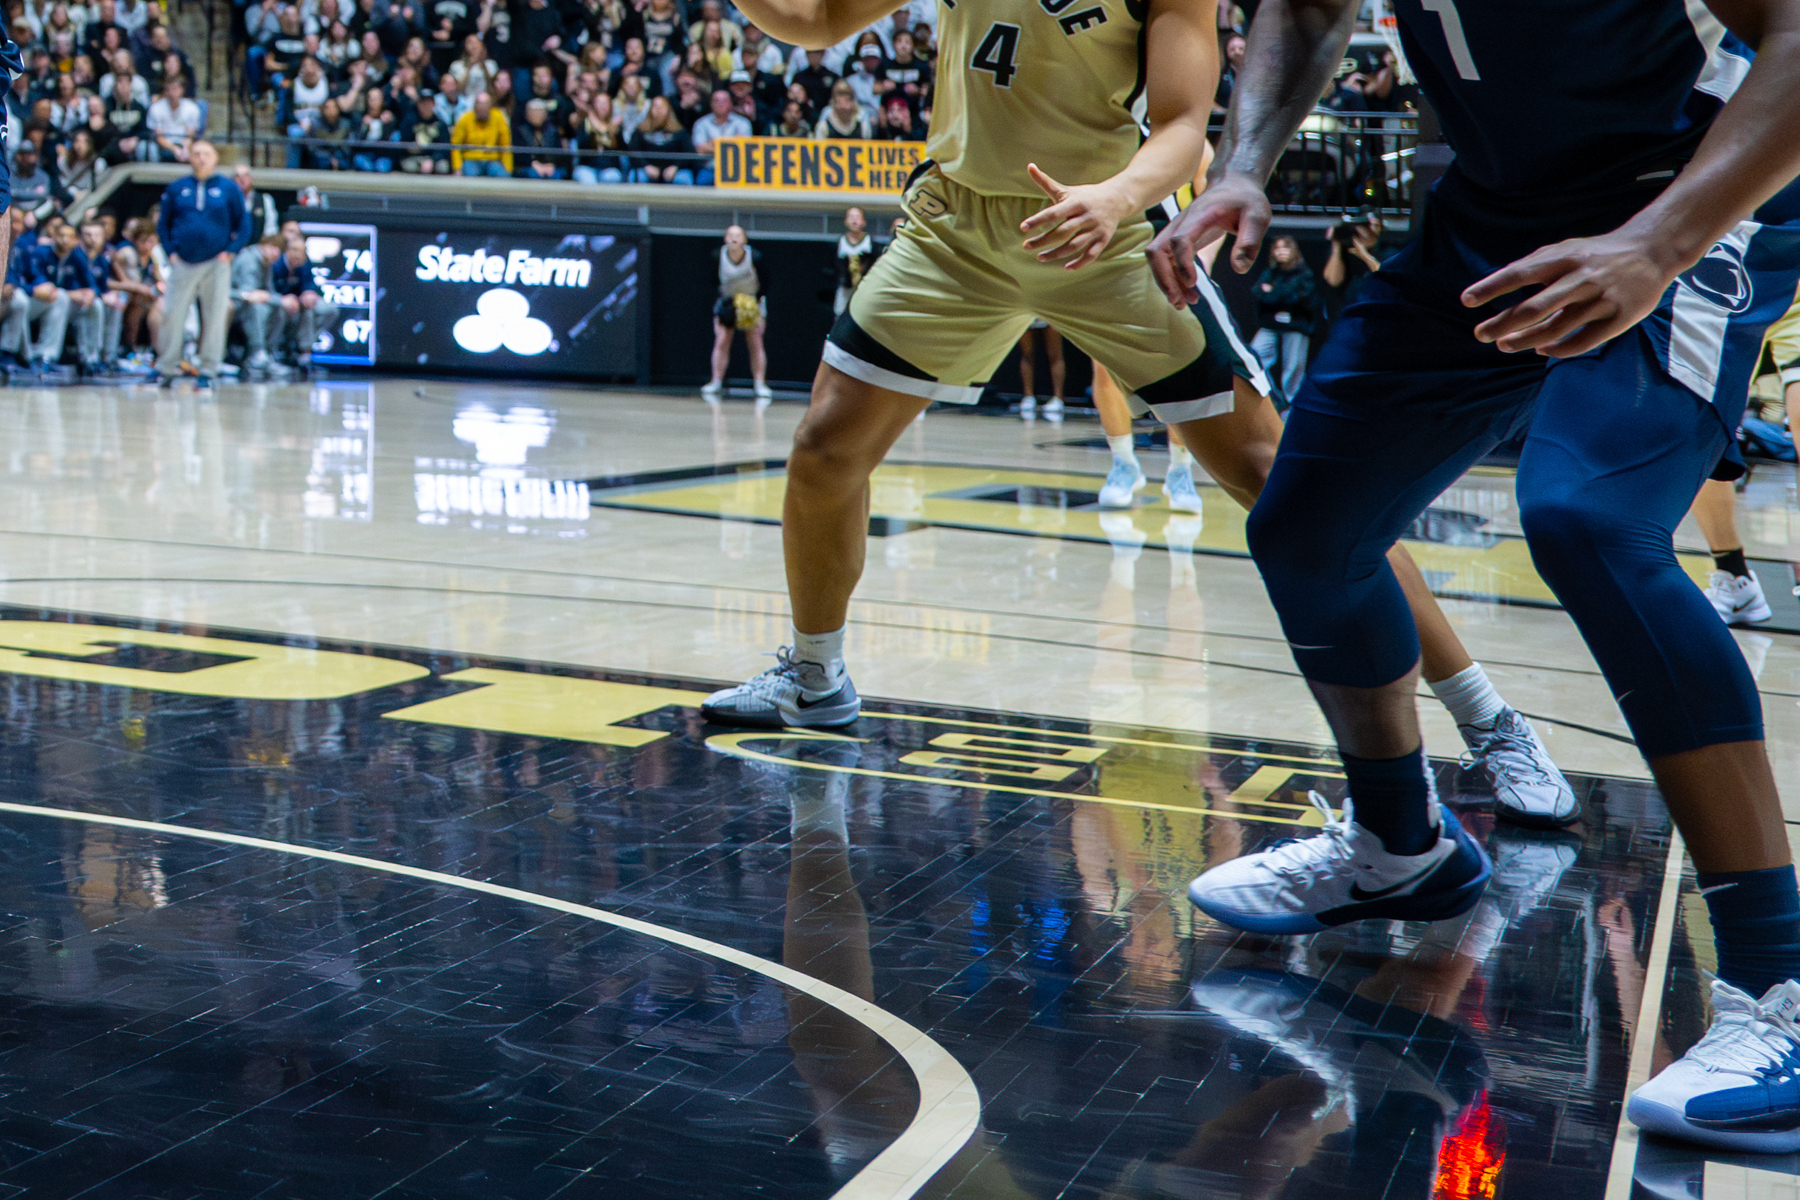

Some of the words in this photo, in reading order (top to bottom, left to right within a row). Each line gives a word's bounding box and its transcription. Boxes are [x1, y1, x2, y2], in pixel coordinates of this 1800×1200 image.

[969, 21, 1021, 89] 4
[720, 143, 864, 187] DEFENSE
[868, 147, 920, 166] LIVES
[869, 170, 907, 189] HER
[342, 249, 373, 274] 74
[415, 244, 592, 288] StateFarm
